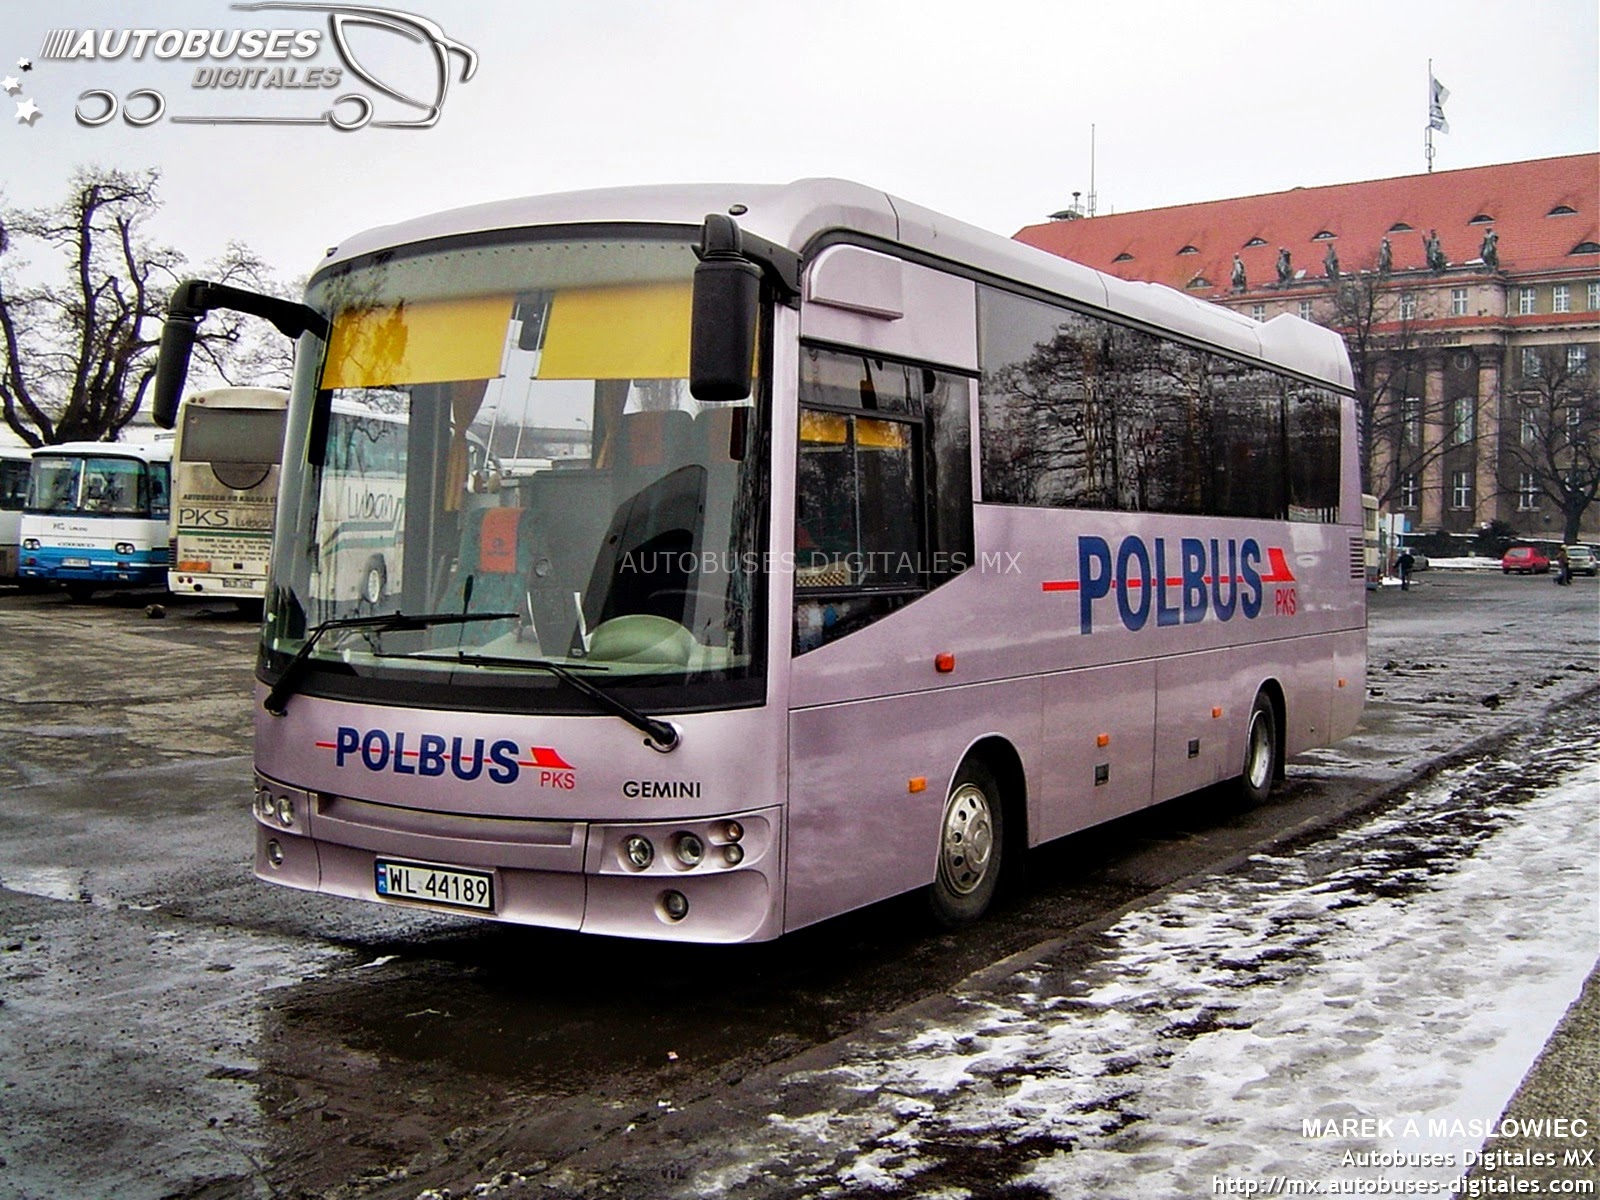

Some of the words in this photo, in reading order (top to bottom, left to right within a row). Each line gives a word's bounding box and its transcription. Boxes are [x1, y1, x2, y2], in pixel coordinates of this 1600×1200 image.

[179, 508, 229, 526] PKS
[1078, 535, 1263, 635] POLBUS
[1275, 588, 1296, 616] PKS
[335, 726, 520, 785] POLBUS
[539, 771, 576, 790] PKS
[622, 780, 702, 799] GEMINI
[390, 867, 417, 894] WL
[425, 873, 488, 904] 44189
